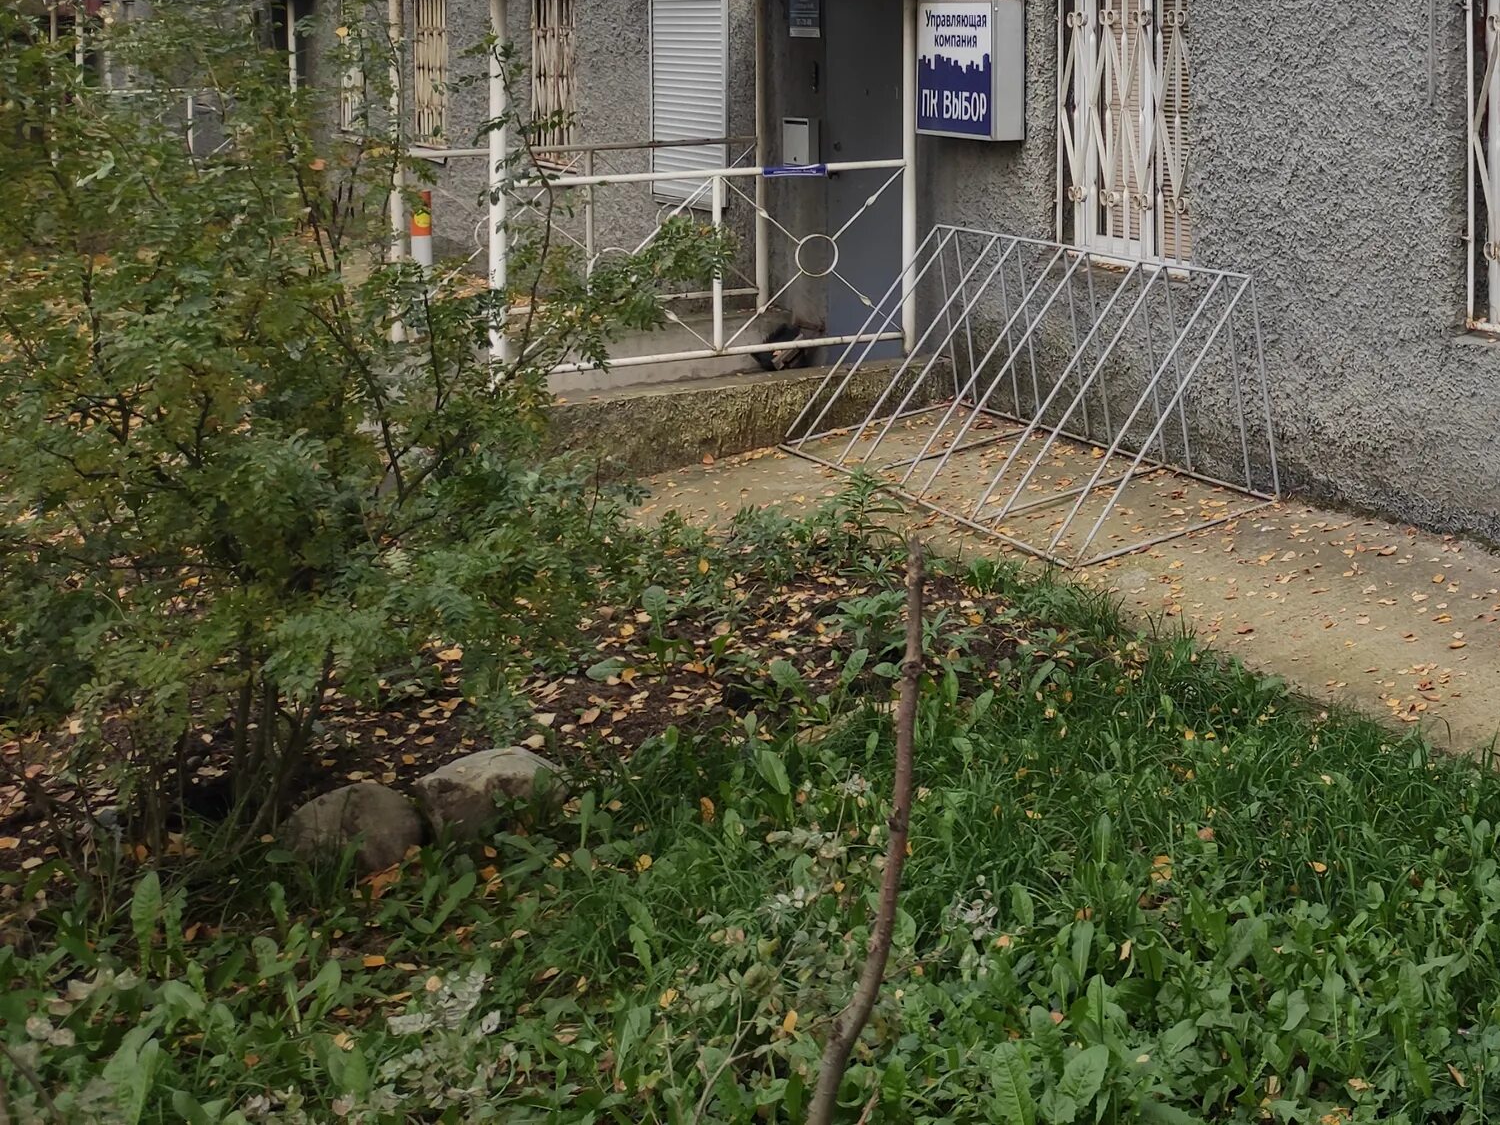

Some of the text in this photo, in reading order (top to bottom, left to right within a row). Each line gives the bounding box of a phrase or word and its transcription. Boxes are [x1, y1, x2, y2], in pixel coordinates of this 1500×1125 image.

[925, 9, 987, 32] Управляющая
[934, 33, 977, 48] компания
[921, 88, 987, 122] ПК ВЫБОР
